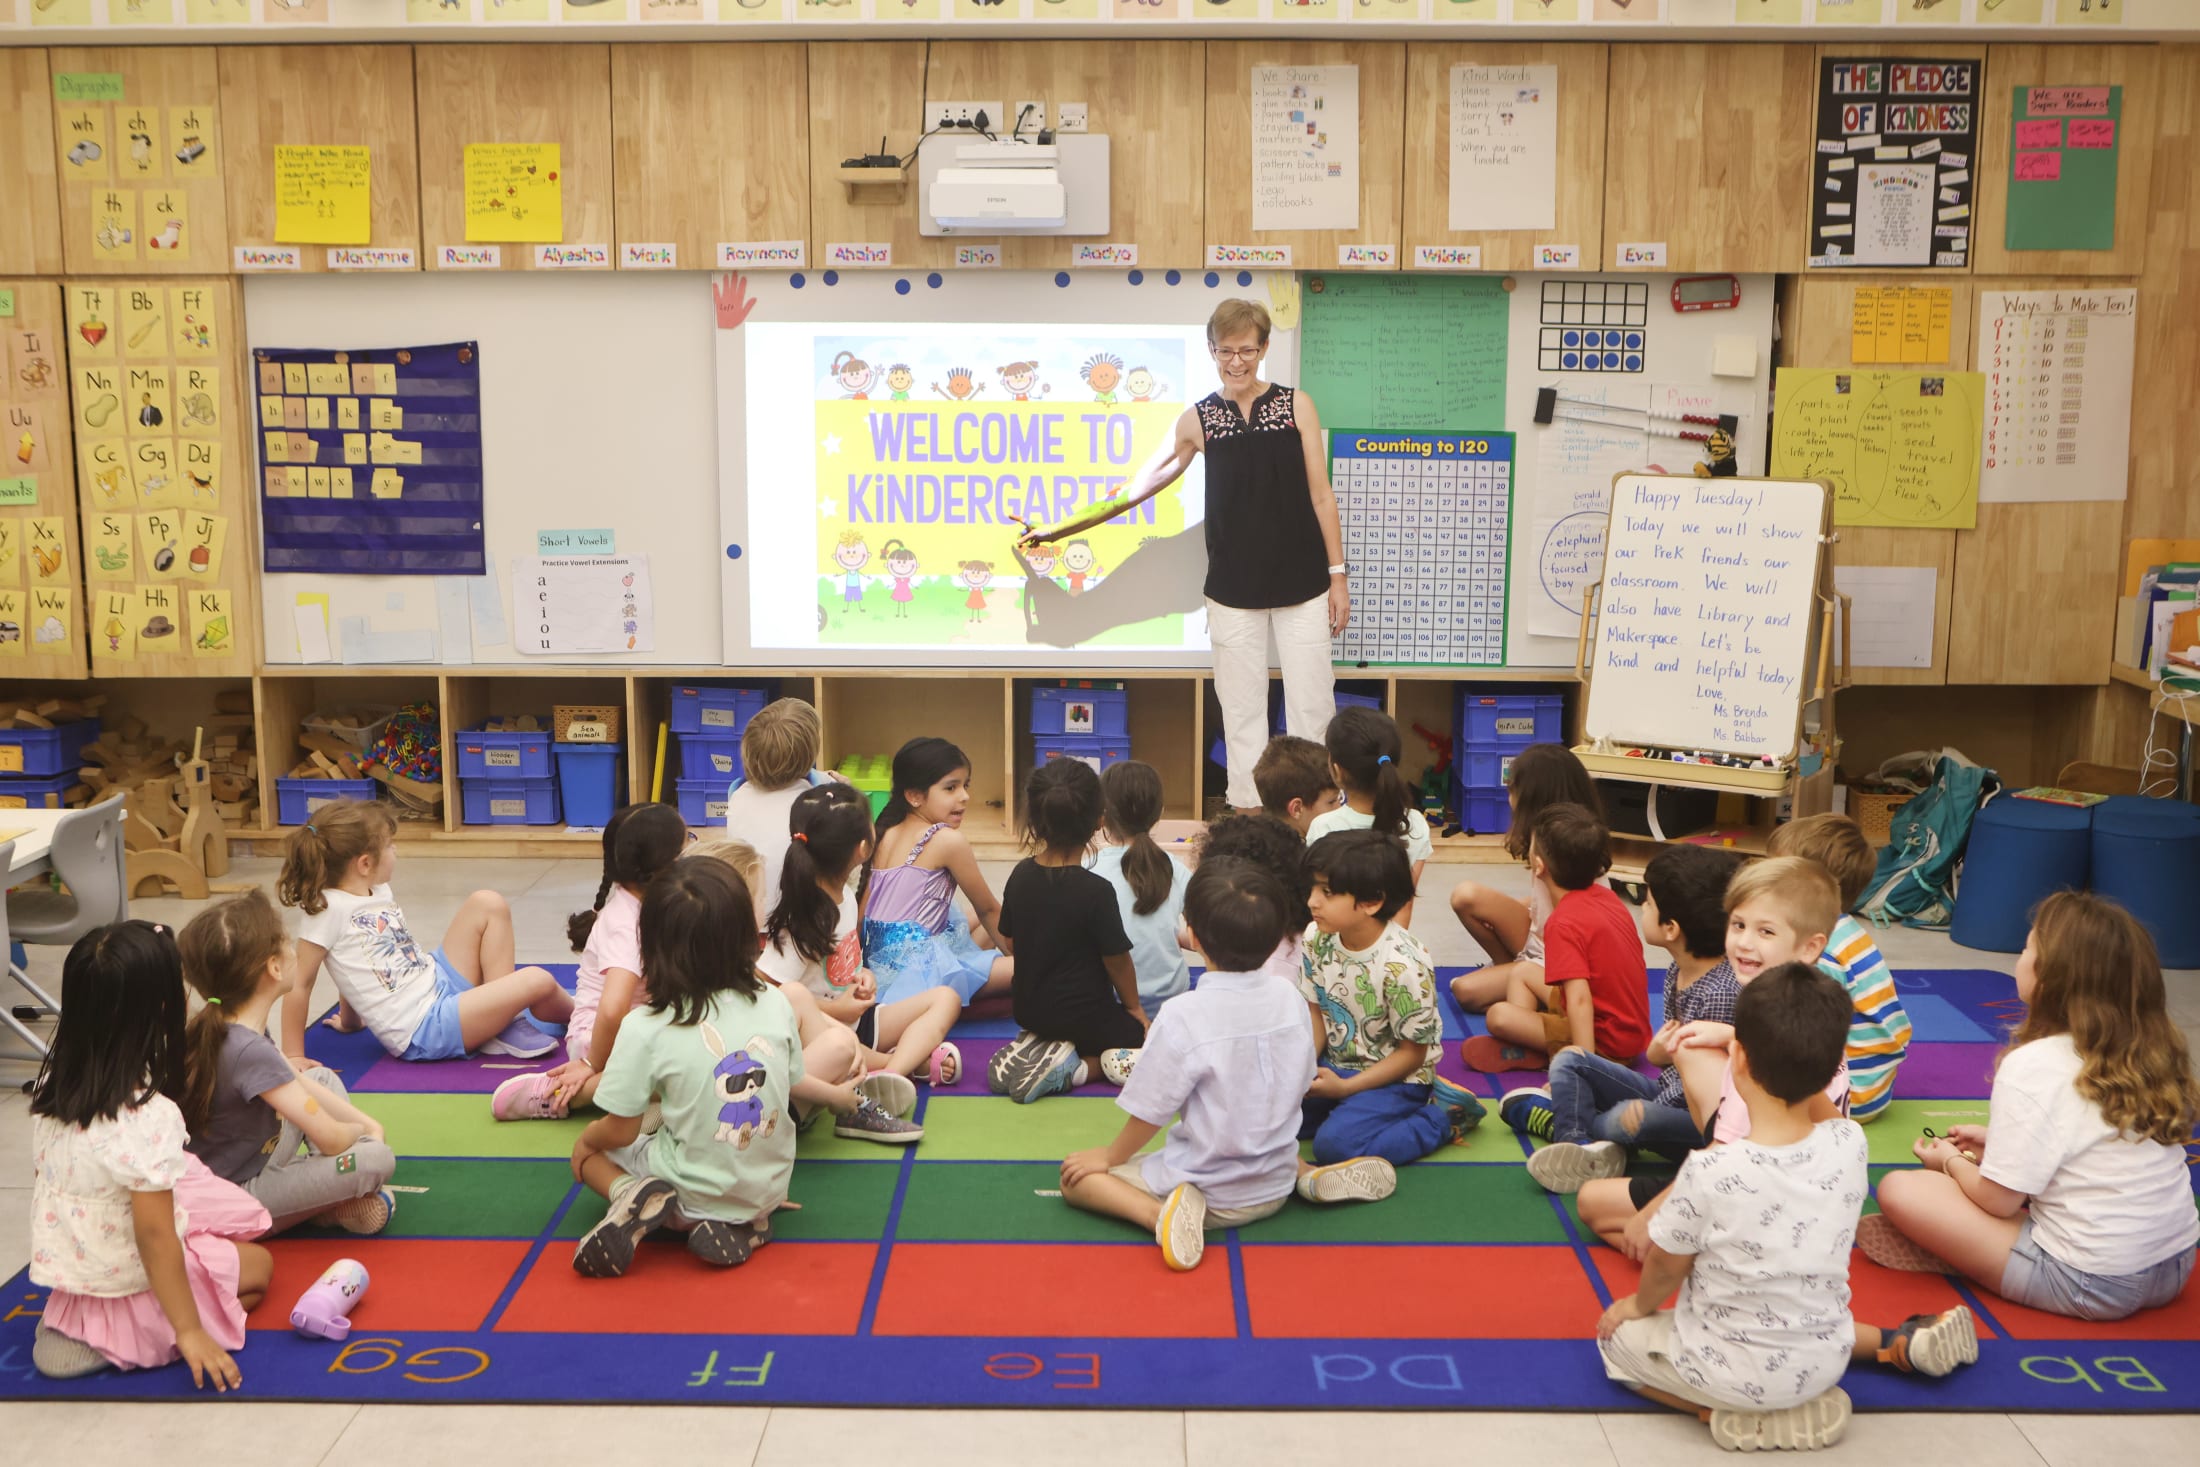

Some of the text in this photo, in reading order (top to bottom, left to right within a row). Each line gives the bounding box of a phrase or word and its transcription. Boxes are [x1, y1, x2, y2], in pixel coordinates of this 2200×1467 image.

[1262, 71, 1278, 82] We
[1463, 68, 1530, 81] Kind Words
[1835, 64, 1968, 91] THE PLEDGE
[61, 76, 119, 97] Digraphs
[1461, 87, 1490, 97] please
[1497, 101, 1513, 113] you
[72, 112, 93, 131] wh
[128, 110, 146, 130] ch
[183, 111, 199, 129] sh
[1262, 112, 1285, 123] paper
[1844, 106, 1968, 131] OF KINDNESS
[1260, 135, 1302, 144] markers
[1460, 143, 1486, 152] When
[1298, 160, 1325, 169] blocks
[105, 194, 122, 212] th
[157, 193, 173, 213] ck
[1263, 196, 1313, 208] notebooks
[243, 251, 294, 264] Maeve
[629, 247, 672, 264] Mark
[725, 244, 799, 262] Raymond
[959, 248, 994, 264] Shio
[1215, 245, 1286, 262] Solomon
[1422, 248, 1473, 265] Wilder
[1624, 249, 1656, 262] Eva
[82, 291, 101, 310] Tt
[131, 292, 153, 310] Bb
[183, 291, 202, 310] Ff
[2003, 296, 2041, 319] Ways
[2053, 294, 2063, 312] to
[2071, 297, 2099, 311] Make
[86, 371, 111, 390] Nn
[131, 370, 164, 389] Mm
[189, 370, 207, 389] Rr
[10, 408, 32, 426] Uu
[869, 412, 1133, 465] WELCOME TO
[1356, 438, 1488, 457] Counting to 120
[94, 445, 117, 462] Cc
[138, 444, 167, 469] Gg
[188, 444, 210, 463] Dd
[1635, 485, 1680, 511] Happy
[33, 521, 54, 540] Xx
[103, 517, 120, 535] Ss
[149, 516, 169, 541] Pp
[197, 517, 213, 544] Jj
[1625, 516, 1802, 540] Today we will show
[540, 534, 608, 546] Short Vowels
[1615, 549, 1638, 558] our
[1654, 545, 1684, 560] PreK
[1702, 547, 1749, 567] friends
[1764, 559, 1790, 569] our
[1551, 561, 1588, 574] focused
[538, 577, 546, 586] a
[1555, 578, 1574, 595] boy
[1705, 574, 1728, 591] We
[1745, 580, 1778, 595] will
[36, 590, 65, 610] Ww
[145, 589, 168, 607] Hh
[200, 594, 220, 612] Kk
[539, 592, 547, 601] e
[542, 607, 546, 618] i
[1607, 598, 1791, 632] also have Library and
[540, 624, 549, 634] o
[541, 639, 550, 648] u
[1701, 632, 1731, 651] Let's
[1745, 638, 1761, 654] be
[1654, 658, 1679, 672] and
[1696, 660, 1747, 683] helpful
[1734, 704, 1768, 718] Brenda
[1733, 718, 1752, 727] and
[1735, 730, 1767, 743] Babbar
[1344, 1167, 1384, 1200] native
